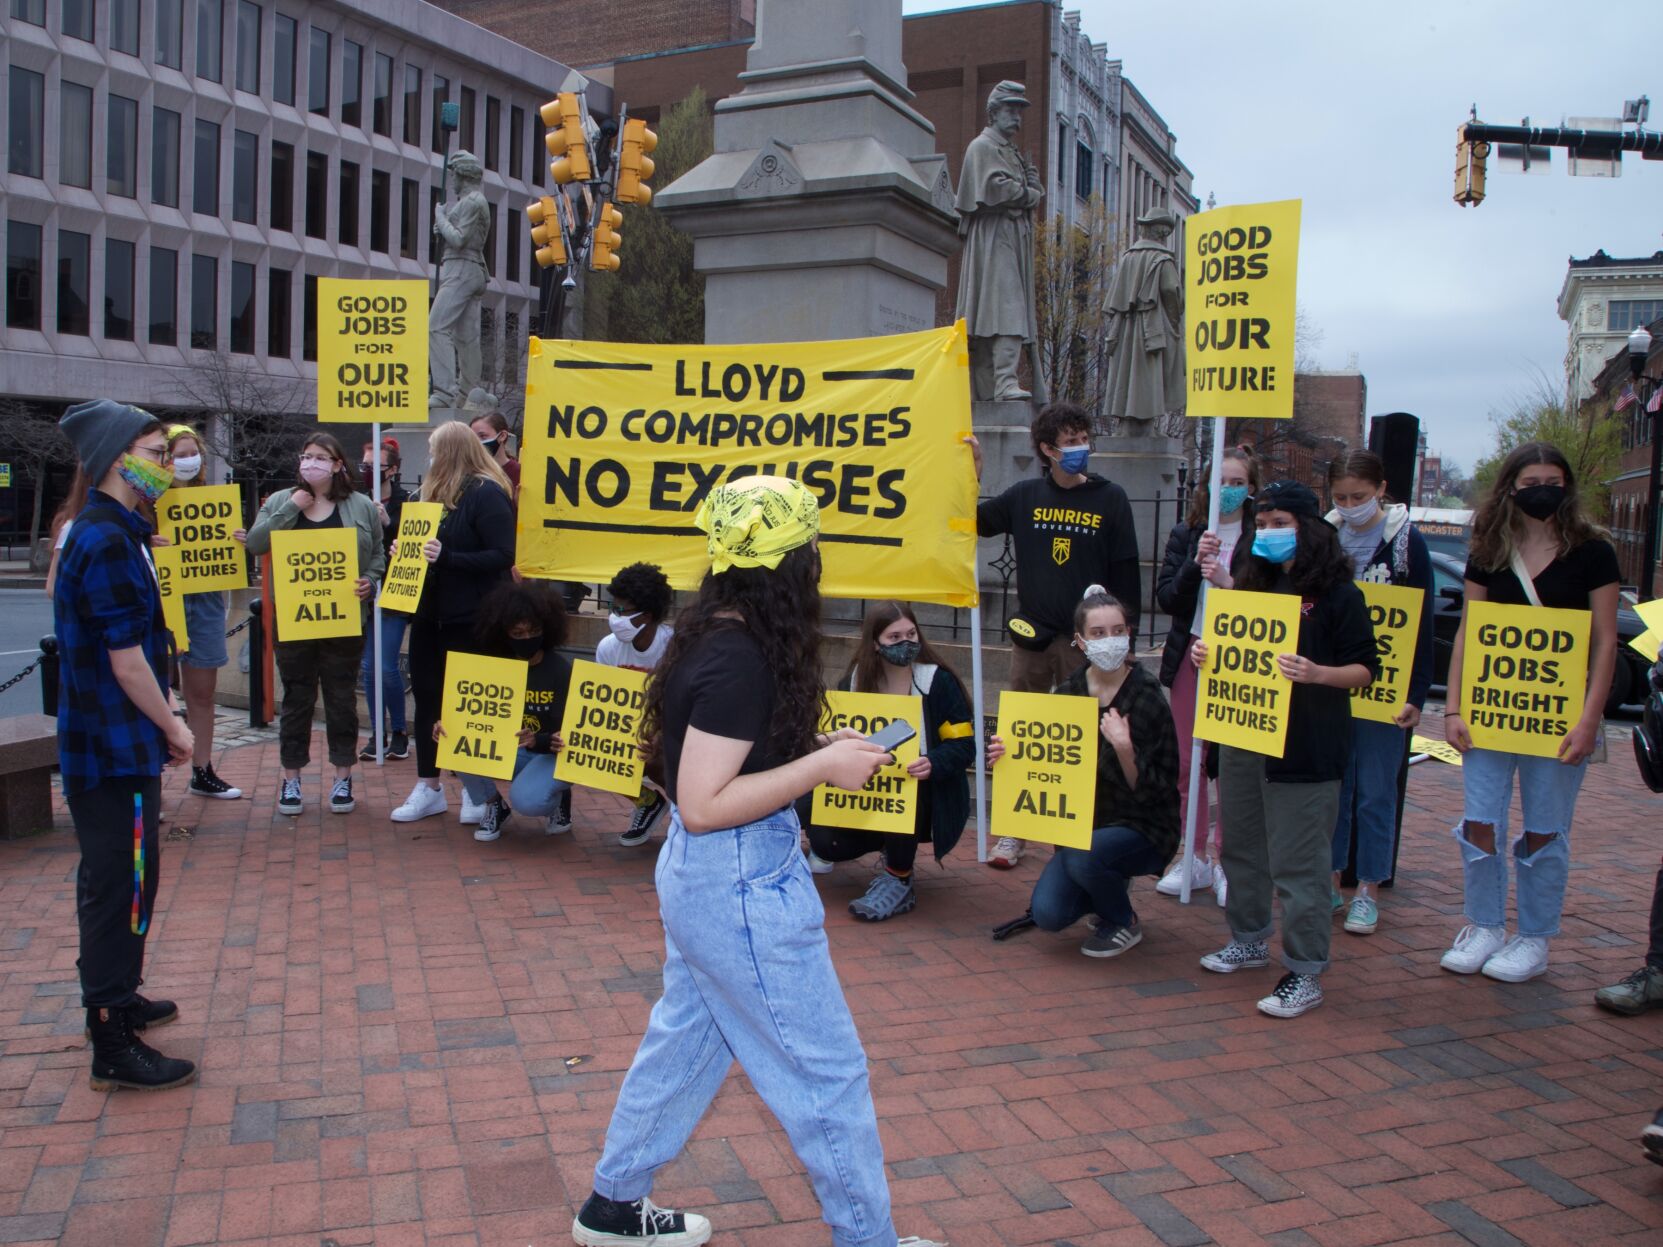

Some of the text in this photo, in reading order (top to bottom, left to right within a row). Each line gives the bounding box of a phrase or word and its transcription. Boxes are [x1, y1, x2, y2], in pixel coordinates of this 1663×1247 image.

[1197, 225, 1272, 256] GOOD
[1197, 253, 1269, 286] JOBS
[337, 296, 407, 313] GOOD
[1205, 291, 1249, 309] FOR
[338, 316, 407, 335] JOBS
[1195, 317, 1271, 352] OUR
[354, 343, 394, 354] FOR
[337, 363, 409, 386] OUR
[675, 359, 806, 403] LLOYD
[1192, 366, 1276, 393] FUTURE
[337, 390, 409, 408] HOME
[547, 404, 912, 448] NO COMPROMISES
[544, 455, 908, 520] NO EXSES
[167, 501, 233, 521] GOOD
[1032, 507, 1103, 529] SUNRISE
[172, 523, 231, 546] JOBS,
[402, 519, 432, 537] GOOD
[1033, 523, 1097, 536] MOVEMENT
[1418, 523, 1463, 536] ANCASTER
[181, 546, 235, 564] RIGHT
[286, 551, 347, 567] GOOD
[397, 541, 423, 562] JOBS,
[181, 563, 238, 579] UTURES
[289, 566, 347, 583] JOBS
[390, 565, 421, 582] BRIGHT
[303, 588, 332, 598] FOR
[386, 582, 418, 597] FUTURES
[294, 601, 347, 622] ALL
[1367, 604, 1408, 629] OD
[1213, 612, 1287, 644] GOOD
[1478, 623, 1575, 653] GOOD
[1211, 644, 1278, 680] JOBS,
[1477, 653, 1565, 688] JOBS,
[456, 680, 515, 701] GOOD
[579, 680, 645, 710] GOOD
[1207, 677, 1280, 710] BRIGHT
[1471, 686, 1569, 715] BRIGHT
[455, 697, 512, 719] JOBS
[1205, 702, 1278, 733] FUTURES
[466, 721, 495, 733] FOR
[575, 705, 635, 738] JOBS,
[830, 713, 904, 736] GOO
[1011, 720, 1084, 742] GOOD
[1470, 709, 1569, 737] FUTURES
[453, 735, 503, 762] ALL
[568, 731, 638, 760] BRIGHT
[1011, 741, 1082, 766] JOBS
[566, 750, 635, 778] FUTURES
[1027, 771, 1062, 784] FOR
[824, 792, 906, 815] FUTURES
[1012, 788, 1076, 820] ALL
